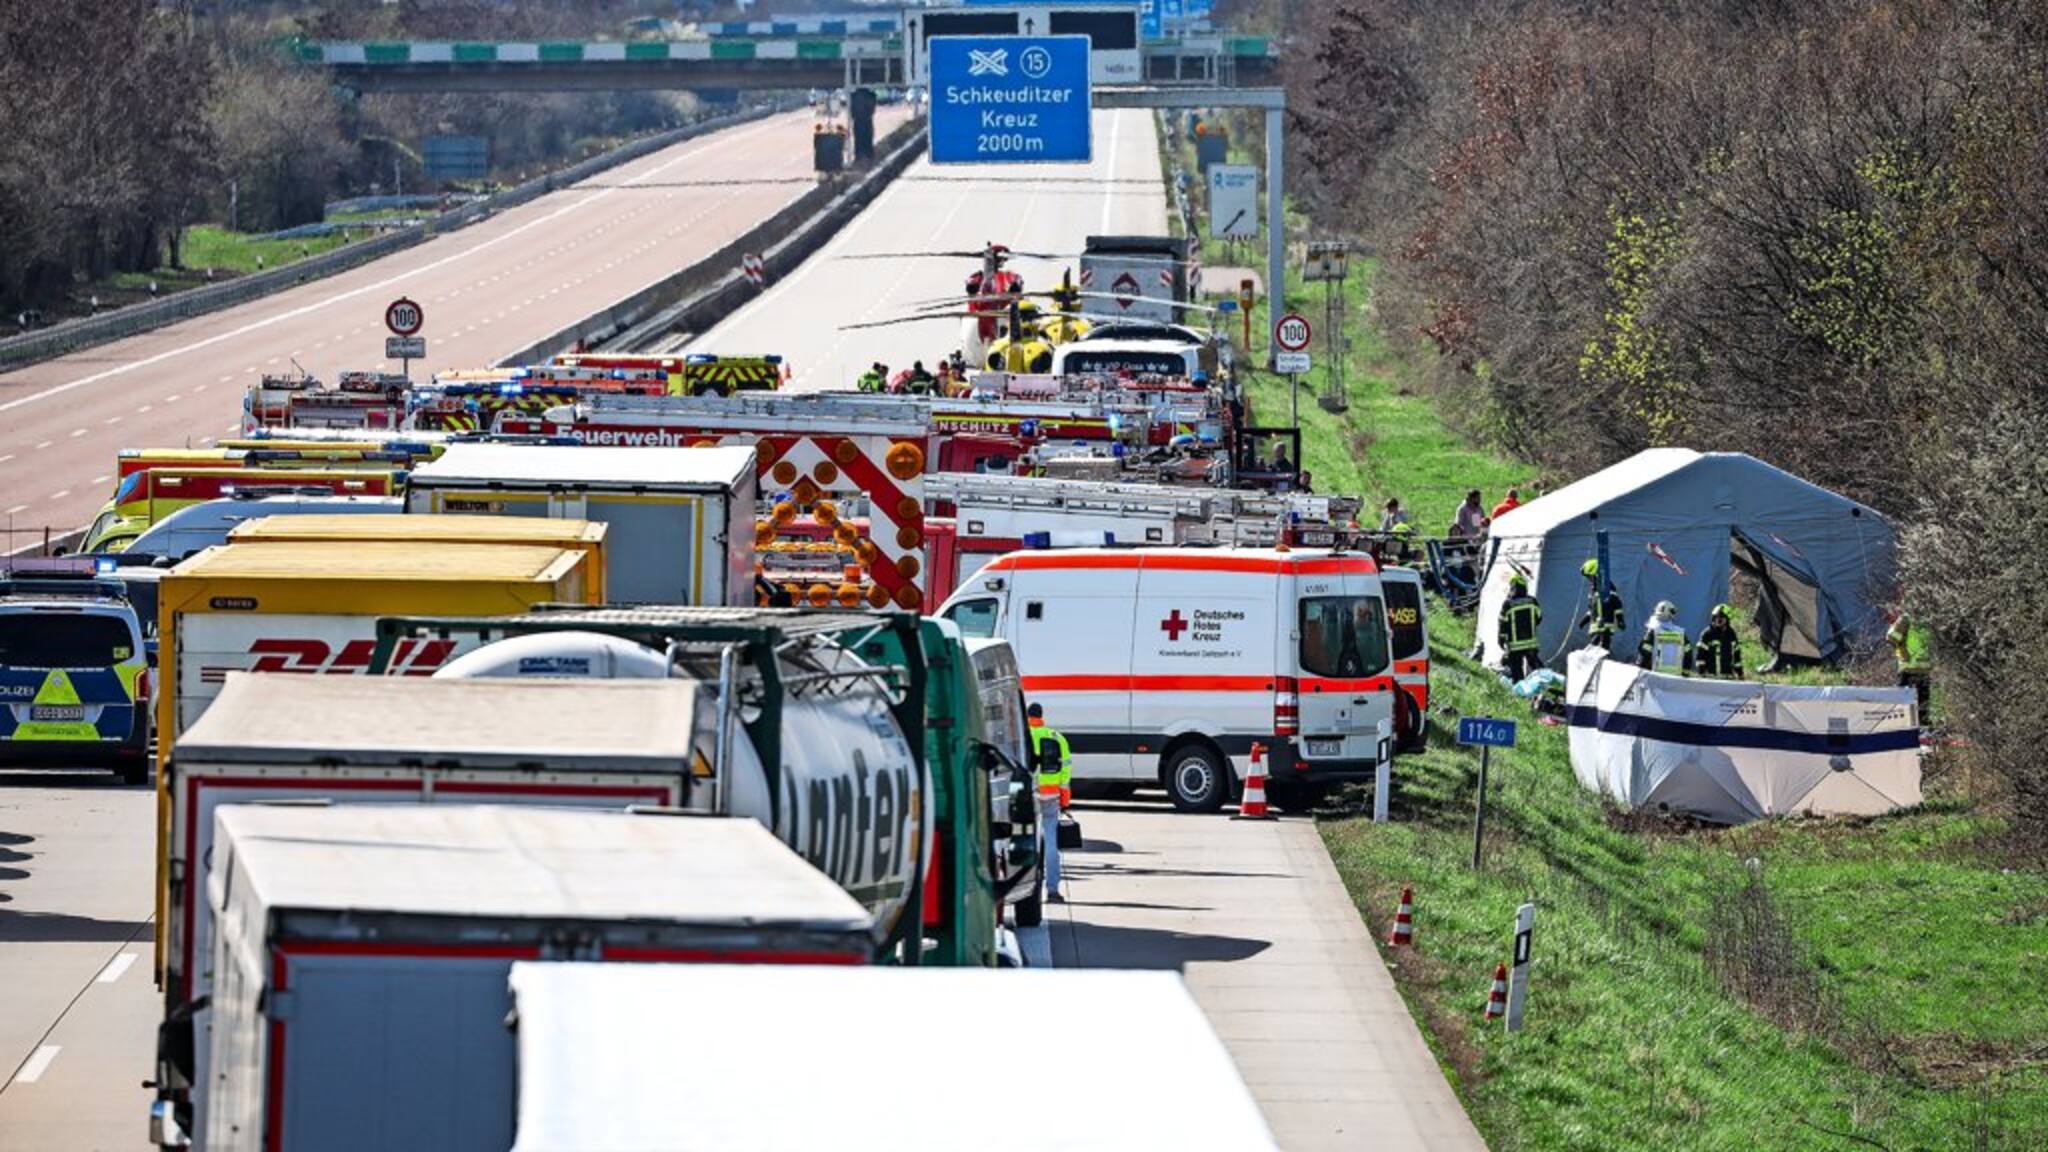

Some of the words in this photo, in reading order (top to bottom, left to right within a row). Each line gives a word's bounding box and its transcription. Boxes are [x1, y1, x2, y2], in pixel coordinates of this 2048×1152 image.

[1027, 53, 1044, 71] 15
[947, 86, 1072, 104] Schkeuditzer
[982, 110, 1038, 127] Kreuz
[394, 309, 416, 327] 100
[1284, 325, 1304, 341] 100
[556, 425, 683, 446] Feuerwehr
[1194, 609, 1245, 620] Deutsches
[1394, 608, 1417, 624] ASB
[1194, 622, 1221, 630] Rotes
[1193, 632, 1221, 641] Kreuz
[0, 686, 34, 696] OLIZEI
